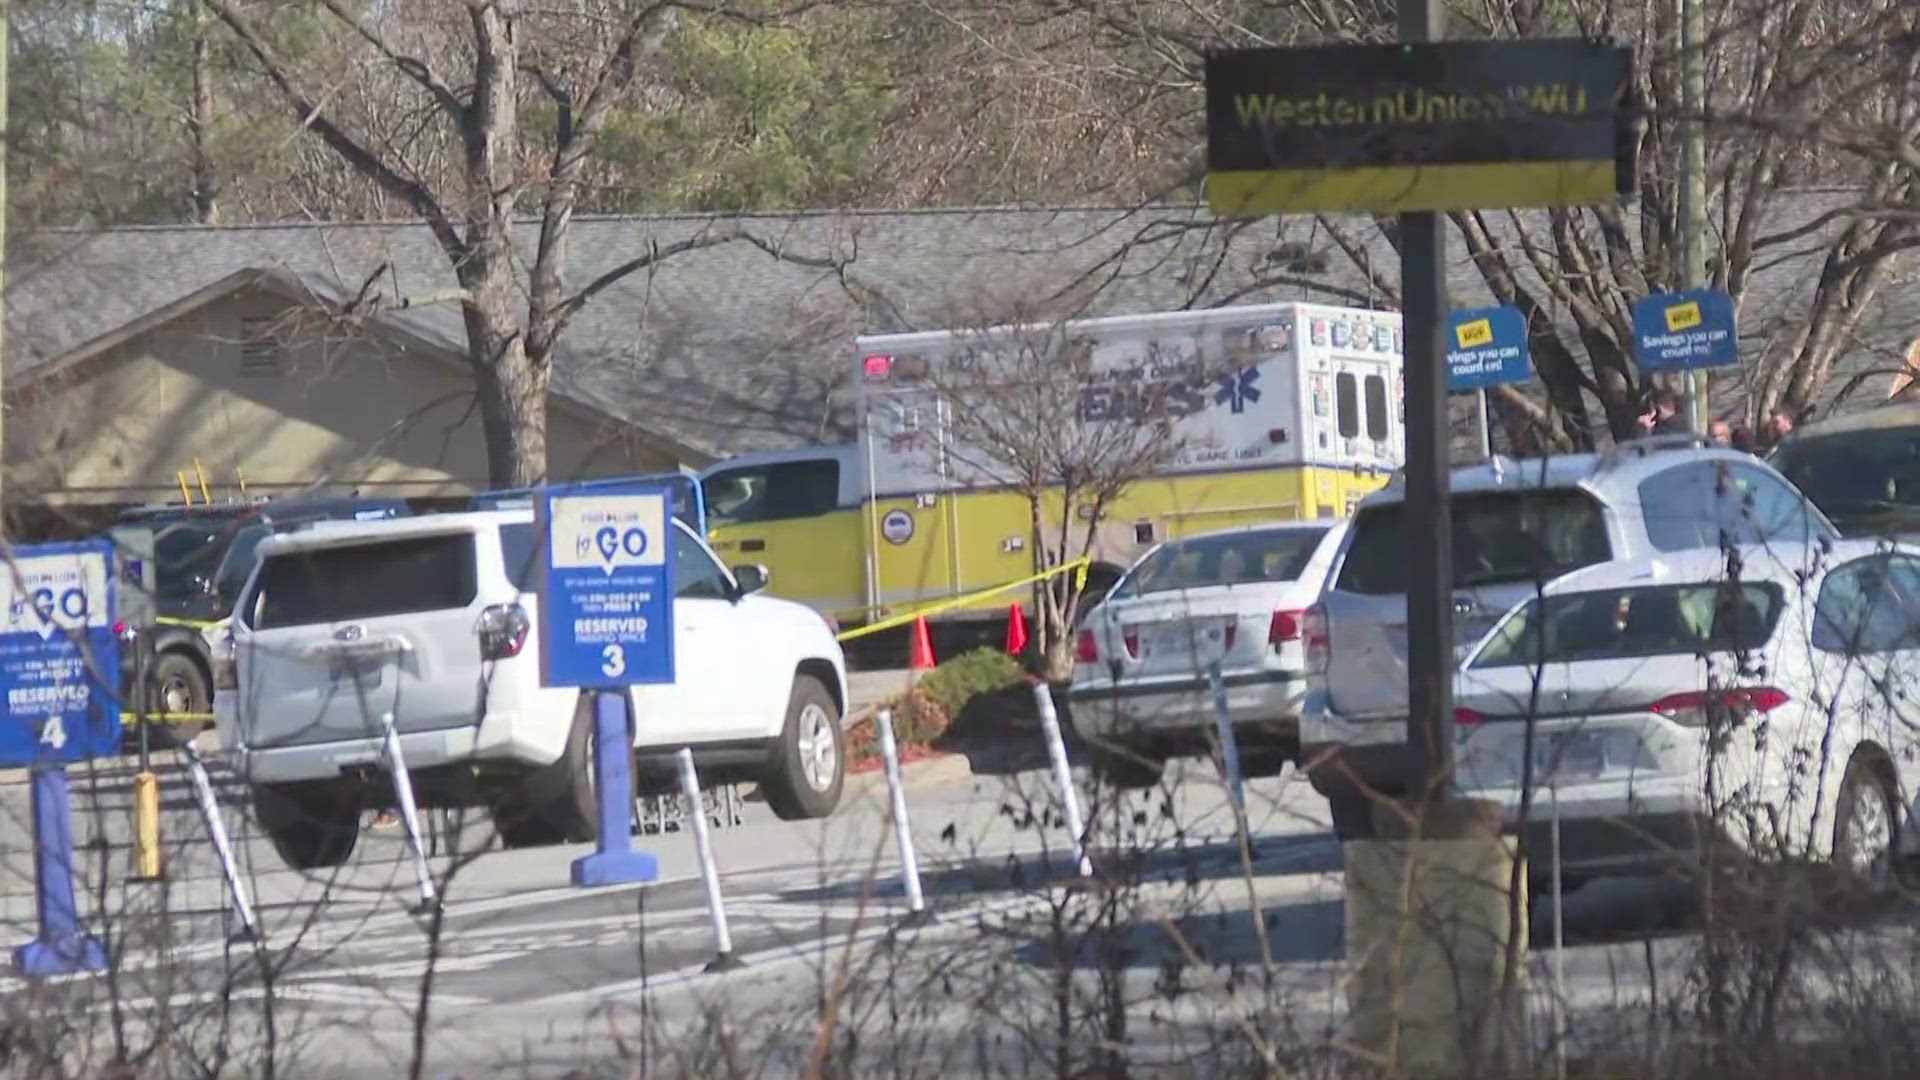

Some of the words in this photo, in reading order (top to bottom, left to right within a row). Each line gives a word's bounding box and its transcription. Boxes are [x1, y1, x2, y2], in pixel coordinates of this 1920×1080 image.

[1643, 333, 1686, 349] Savings
[1686, 331, 1708, 347] you
[1708, 329, 1728, 341] can
[1447, 349, 1478, 366] vings
[1478, 348, 1498, 364] you
[1500, 346, 1519, 358] can
[1452, 360, 1484, 376] count
[596, 526, 648, 563] GO
[34, 587, 87, 623] GO
[574, 617, 648, 633] RESERVED
[601, 643, 626, 678] 3
[8, 685, 90, 704] RESERVED
[40, 715, 67, 748] 4
